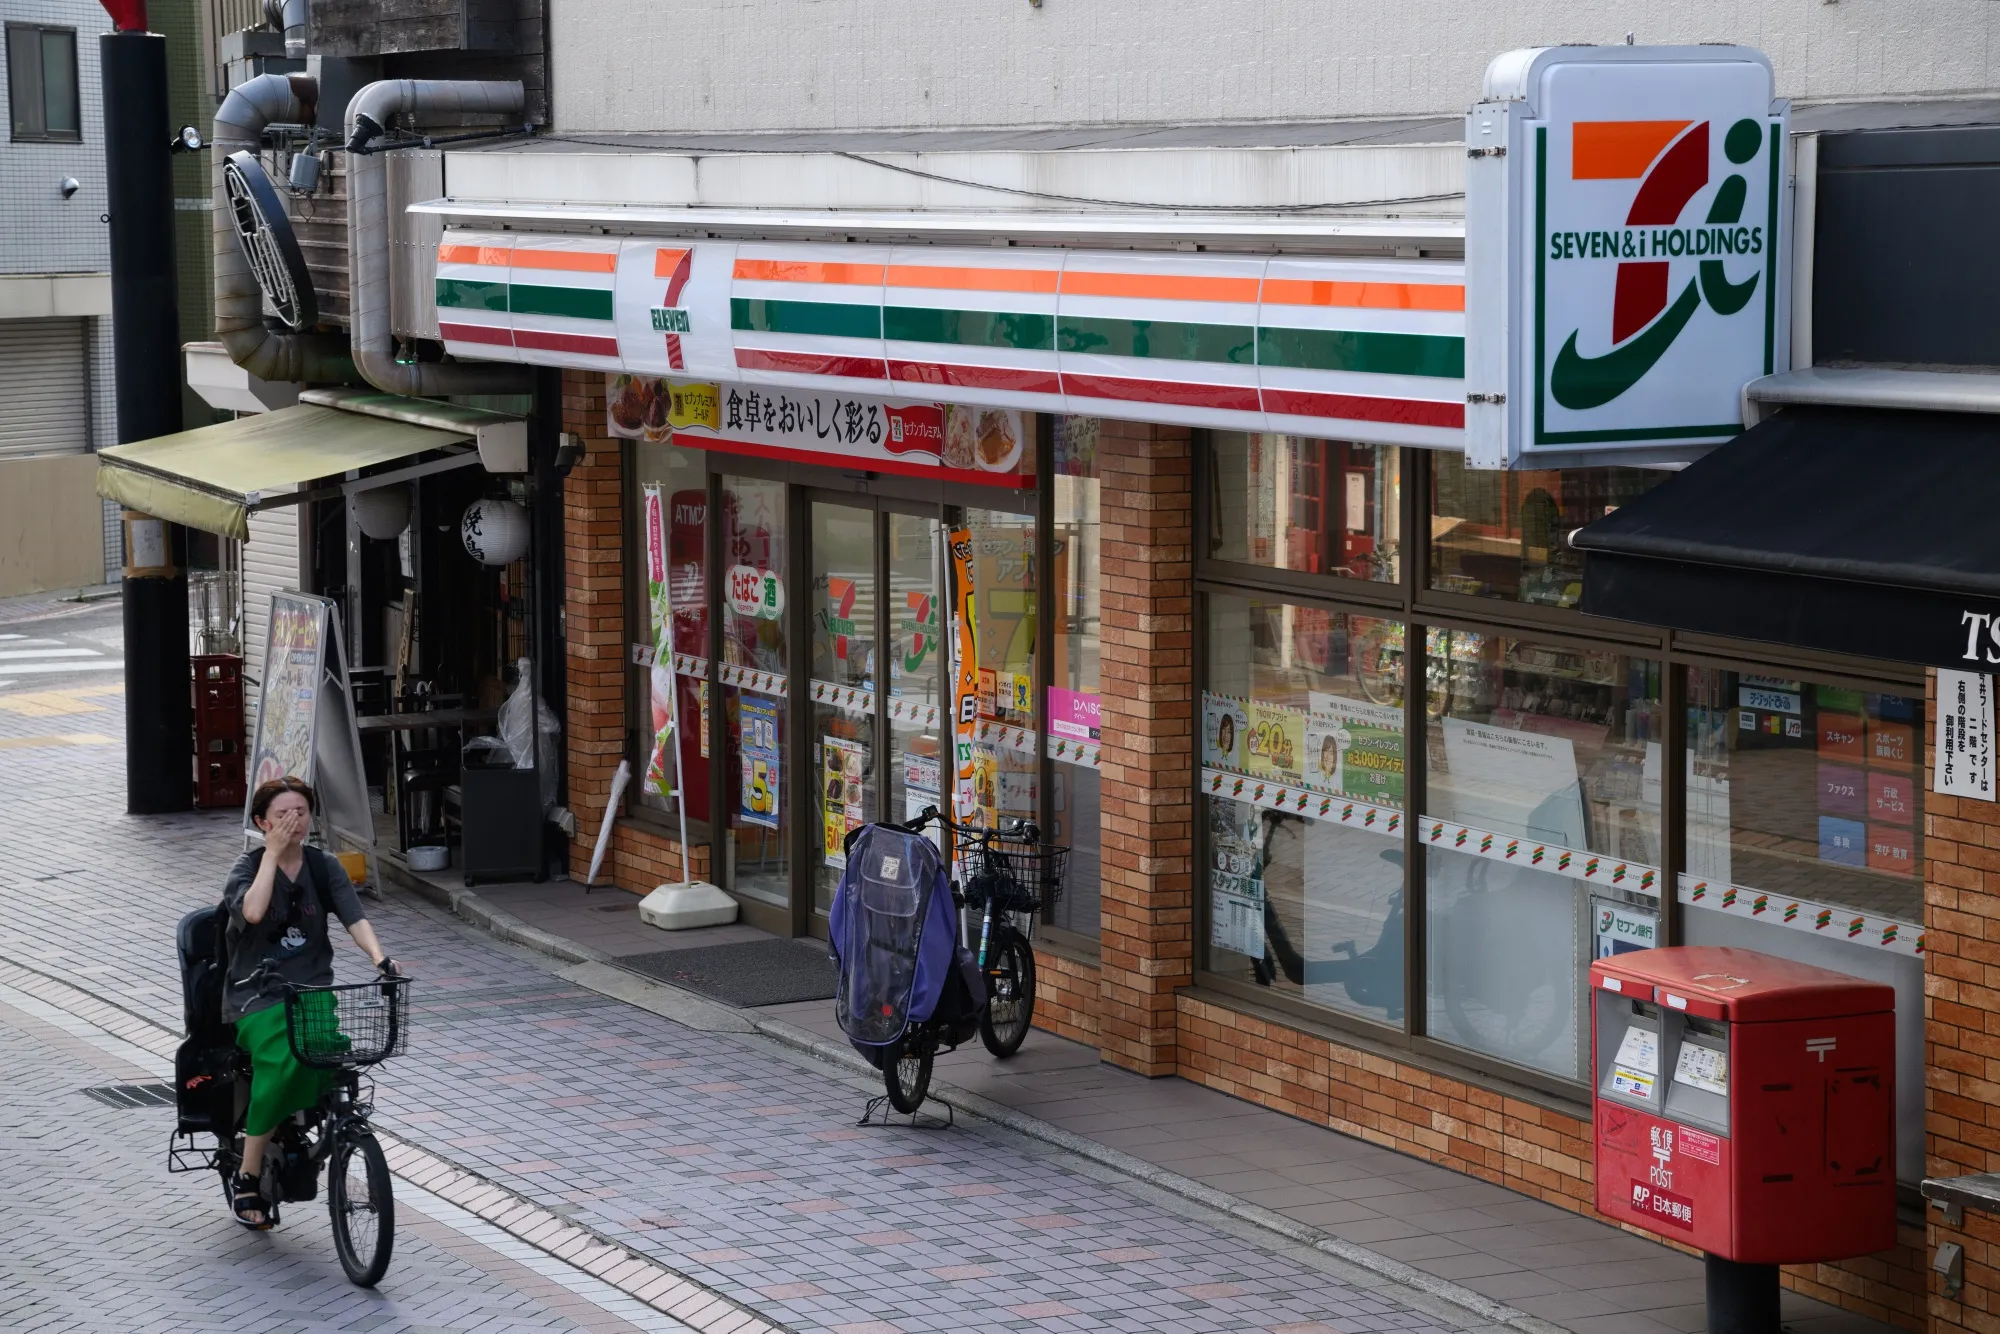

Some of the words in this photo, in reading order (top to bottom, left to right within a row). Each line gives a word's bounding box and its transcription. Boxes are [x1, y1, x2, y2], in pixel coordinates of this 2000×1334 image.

[1652, 226, 1763, 258] HOLDINGS
[654, 247, 693, 370] 7
[726, 388, 882, 444] 食卓をおいしく彩る
[903, 421, 942, 440] セブンプレミアム
[731, 571, 760, 604] たばこ
[763, 576, 777, 607] 酒
[1255, 708, 1288, 722] 7NOWアプリで
[1957, 679, 1966, 753] 右側の階段を
[1787, 721, 1801, 735] JTB
[1826, 731, 1855, 744] スキャン
[1875, 732, 1904, 747] スポーツ
[1875, 744, 1904, 760] 振興くじ
[1944, 714, 1955, 787] 御利用下さい
[1969, 717, 1977, 784] 二階です
[1369, 772, 1387, 785] お届け
[1827, 783, 1855, 797] ファクス
[1883, 786, 1898, 799] 行政
[1876, 798, 1905, 813] サービス
[1833, 835, 1850, 849] 保険
[1874, 843, 1890, 857] 学び
[1892, 847, 1908, 860] 教育
[1212, 871, 1260, 899] スタッフ募集!
[1616, 918, 1653, 939] セブン銀行
[1650, 1125, 1673, 1152] 郵便
[1650, 1165, 1673, 1190] POST
[1633, 1184, 1650, 1202] JP
[1632, 1200, 1649, 1210] POST
[1653, 1194, 1692, 1223] 日本郵便
